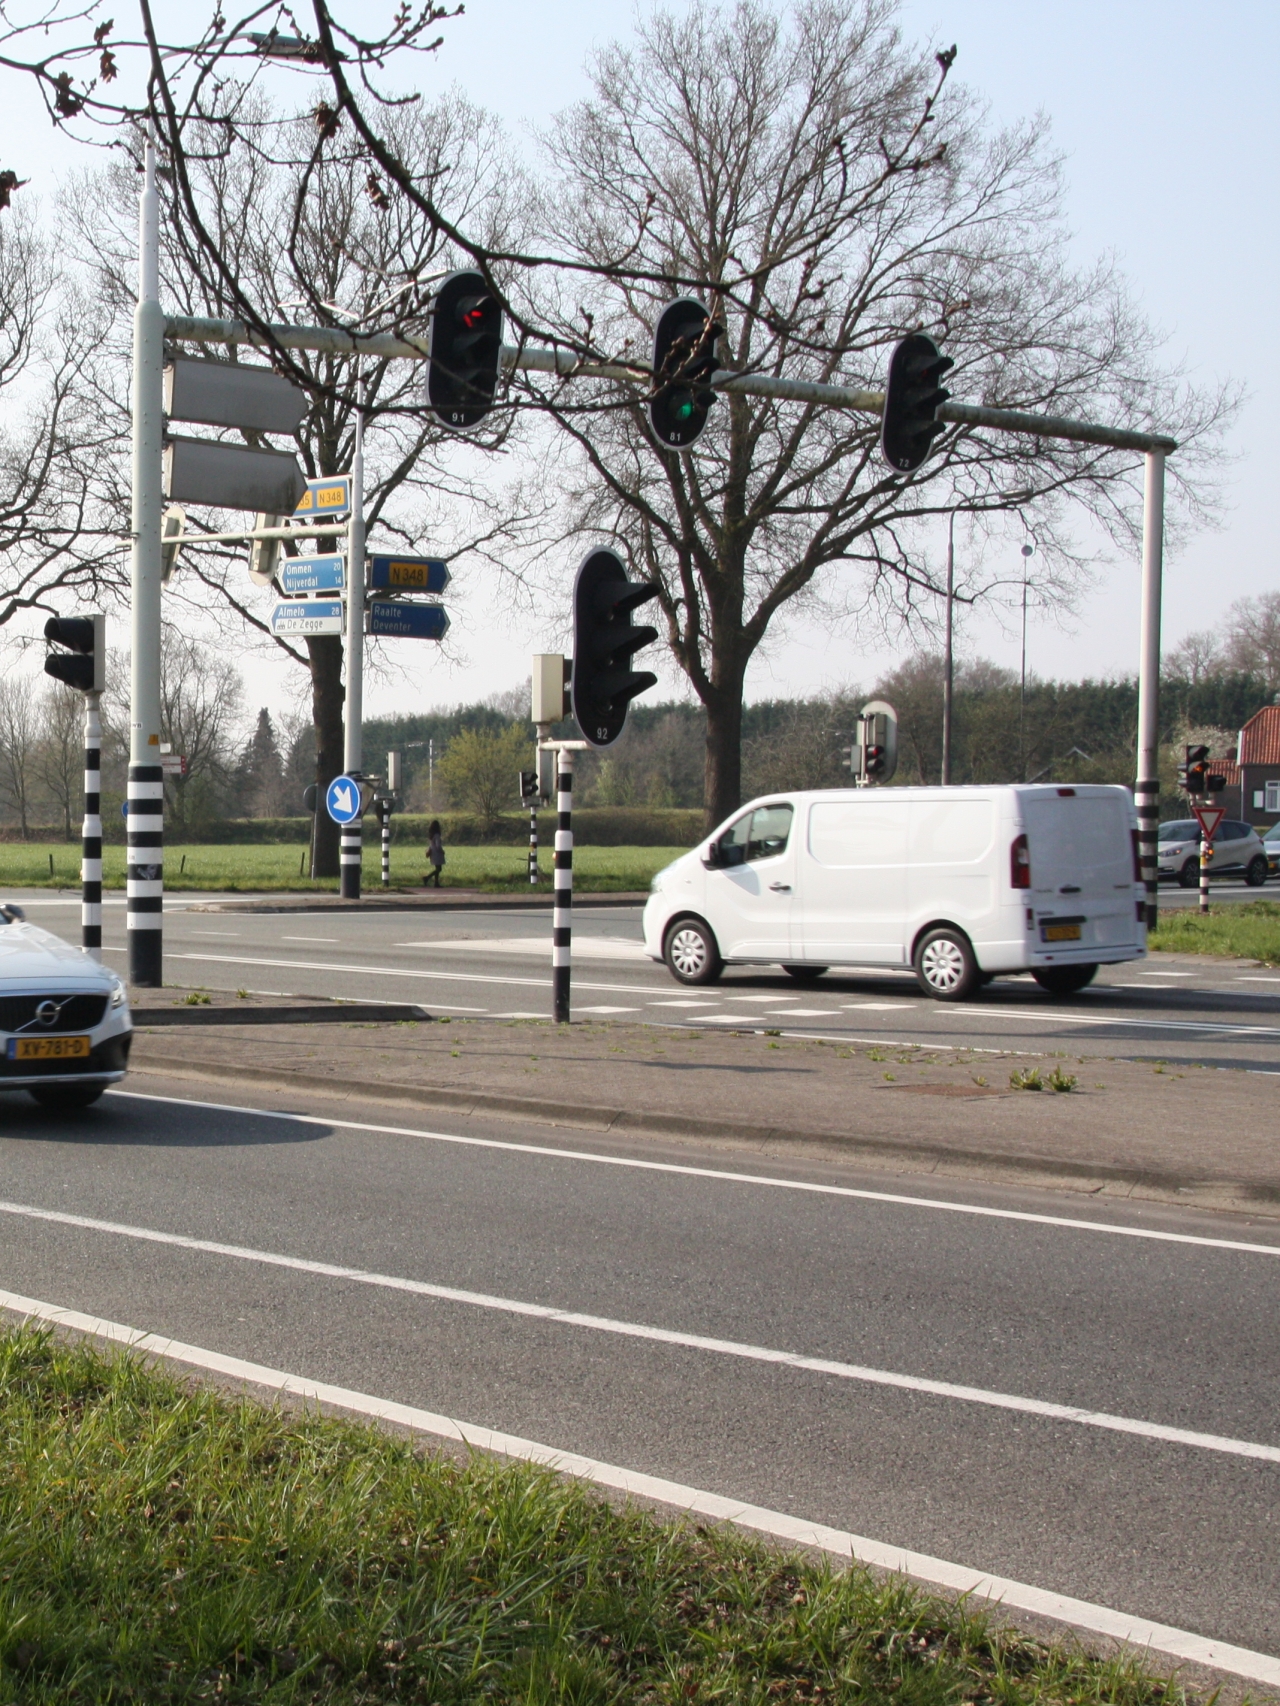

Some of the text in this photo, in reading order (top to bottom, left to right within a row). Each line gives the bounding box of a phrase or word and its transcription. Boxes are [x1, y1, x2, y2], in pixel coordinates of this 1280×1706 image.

[286, 562, 341, 575] Ommen 20
[286, 576, 342, 590] Nijverdal 14
[278, 606, 340, 617] Almelo 28
[374, 605, 402, 618] Raalte
[287, 619, 324, 632] De Zegge
[373, 620, 411, 632] Deventer
[22, 1040, 83, 1056] XV-781-D
